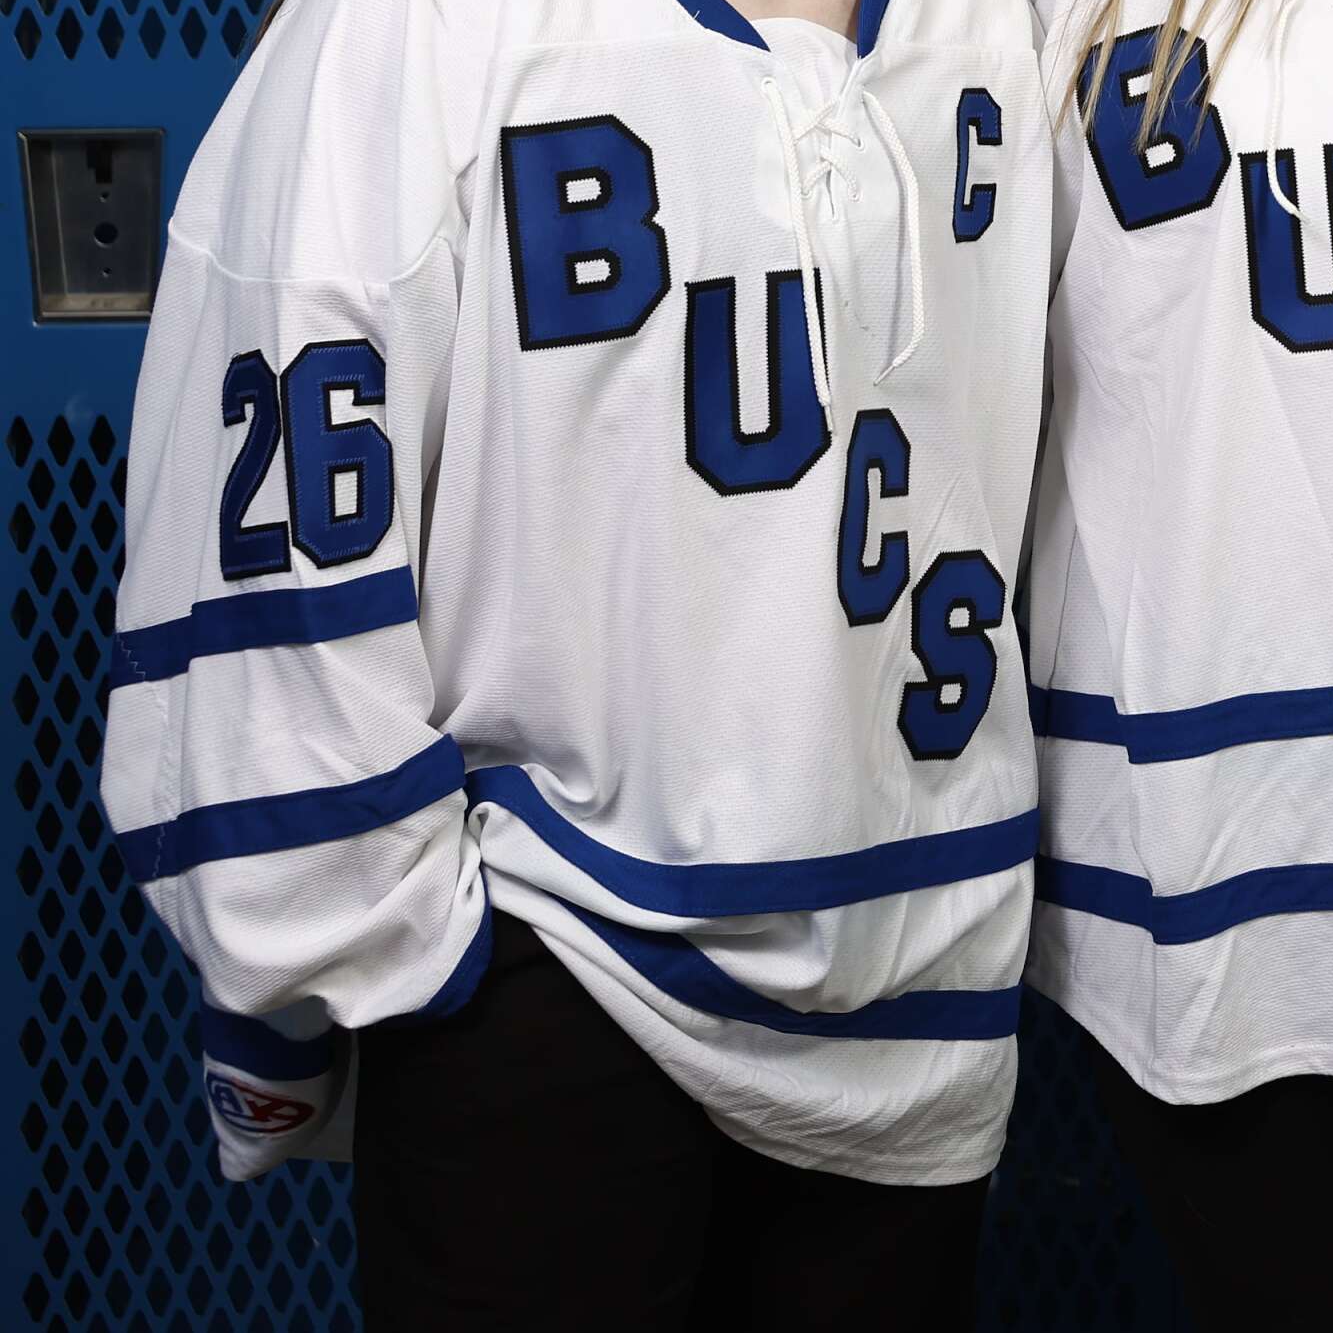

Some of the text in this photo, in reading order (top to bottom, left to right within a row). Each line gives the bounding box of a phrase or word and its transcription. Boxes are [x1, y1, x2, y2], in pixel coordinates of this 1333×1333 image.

[951, 87, 1003, 243] C
[220, 339, 394, 581] 26
[499, 114, 1005, 760] BUCS
